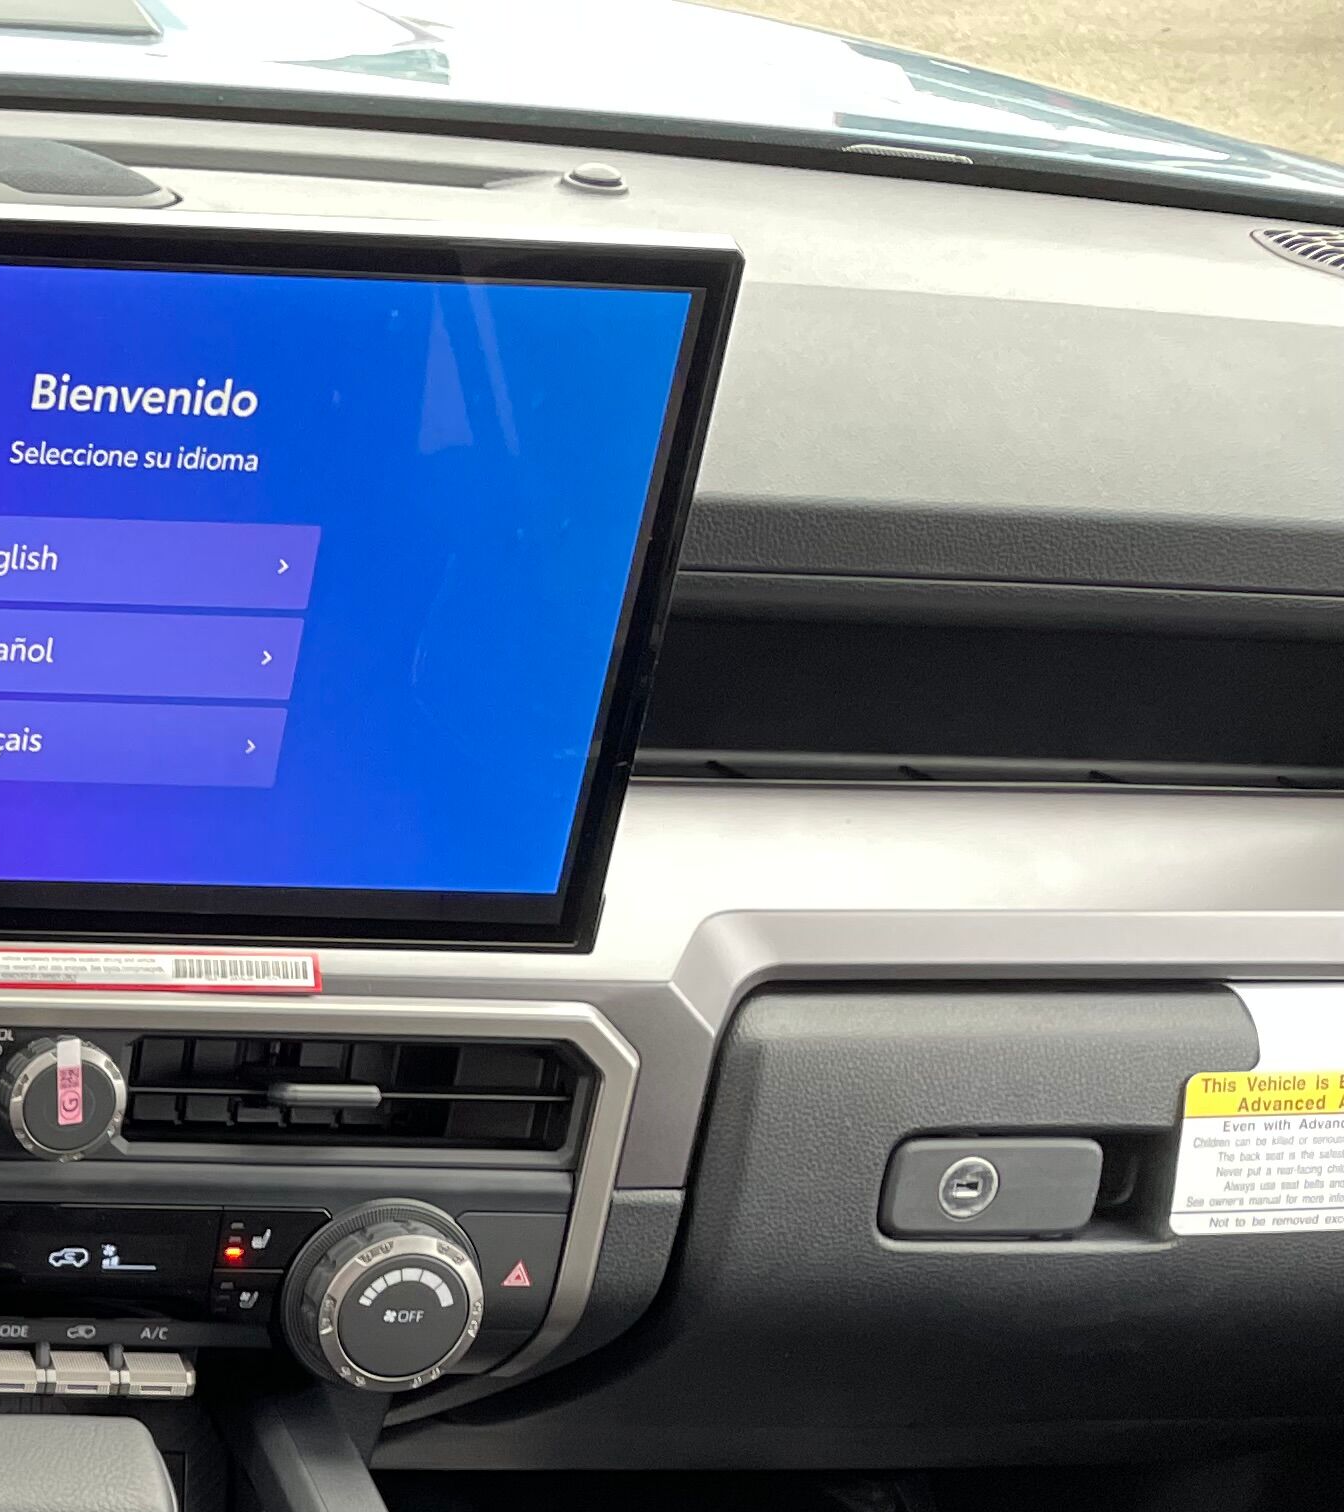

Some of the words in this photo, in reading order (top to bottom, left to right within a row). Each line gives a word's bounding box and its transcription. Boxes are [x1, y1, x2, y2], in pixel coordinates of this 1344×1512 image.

[31, 372, 259, 418] Bienvenido
[9, 441, 138, 469] Seleccione
[143, 449, 171, 469] su
[177, 446, 259, 472] idioma
[1201, 1077, 1237, 1094] This
[1247, 1075, 1307, 1093] Vehicle
[1237, 1095, 1327, 1113] Advanced
[1223, 1120, 1256, 1133] Even
[1264, 1118, 1291, 1132] with
[1193, 1136, 1231, 1149] Children
[1218, 1151, 1235, 1162] The
[1240, 1150, 1260, 1162] back
[1216, 1166, 1243, 1178] Never
[1247, 1166, 1261, 1178] put
[1186, 1196, 1204, 1208] See
[1209, 1216, 1229, 1229] Not
[1235, 1216, 1246, 1227] to
[1252, 1215, 1265, 1227] be
[1272, 1214, 1319, 1226] removed
[398, 1310, 424, 1323] OFF
[140, 1327, 168, 1341] A/C
